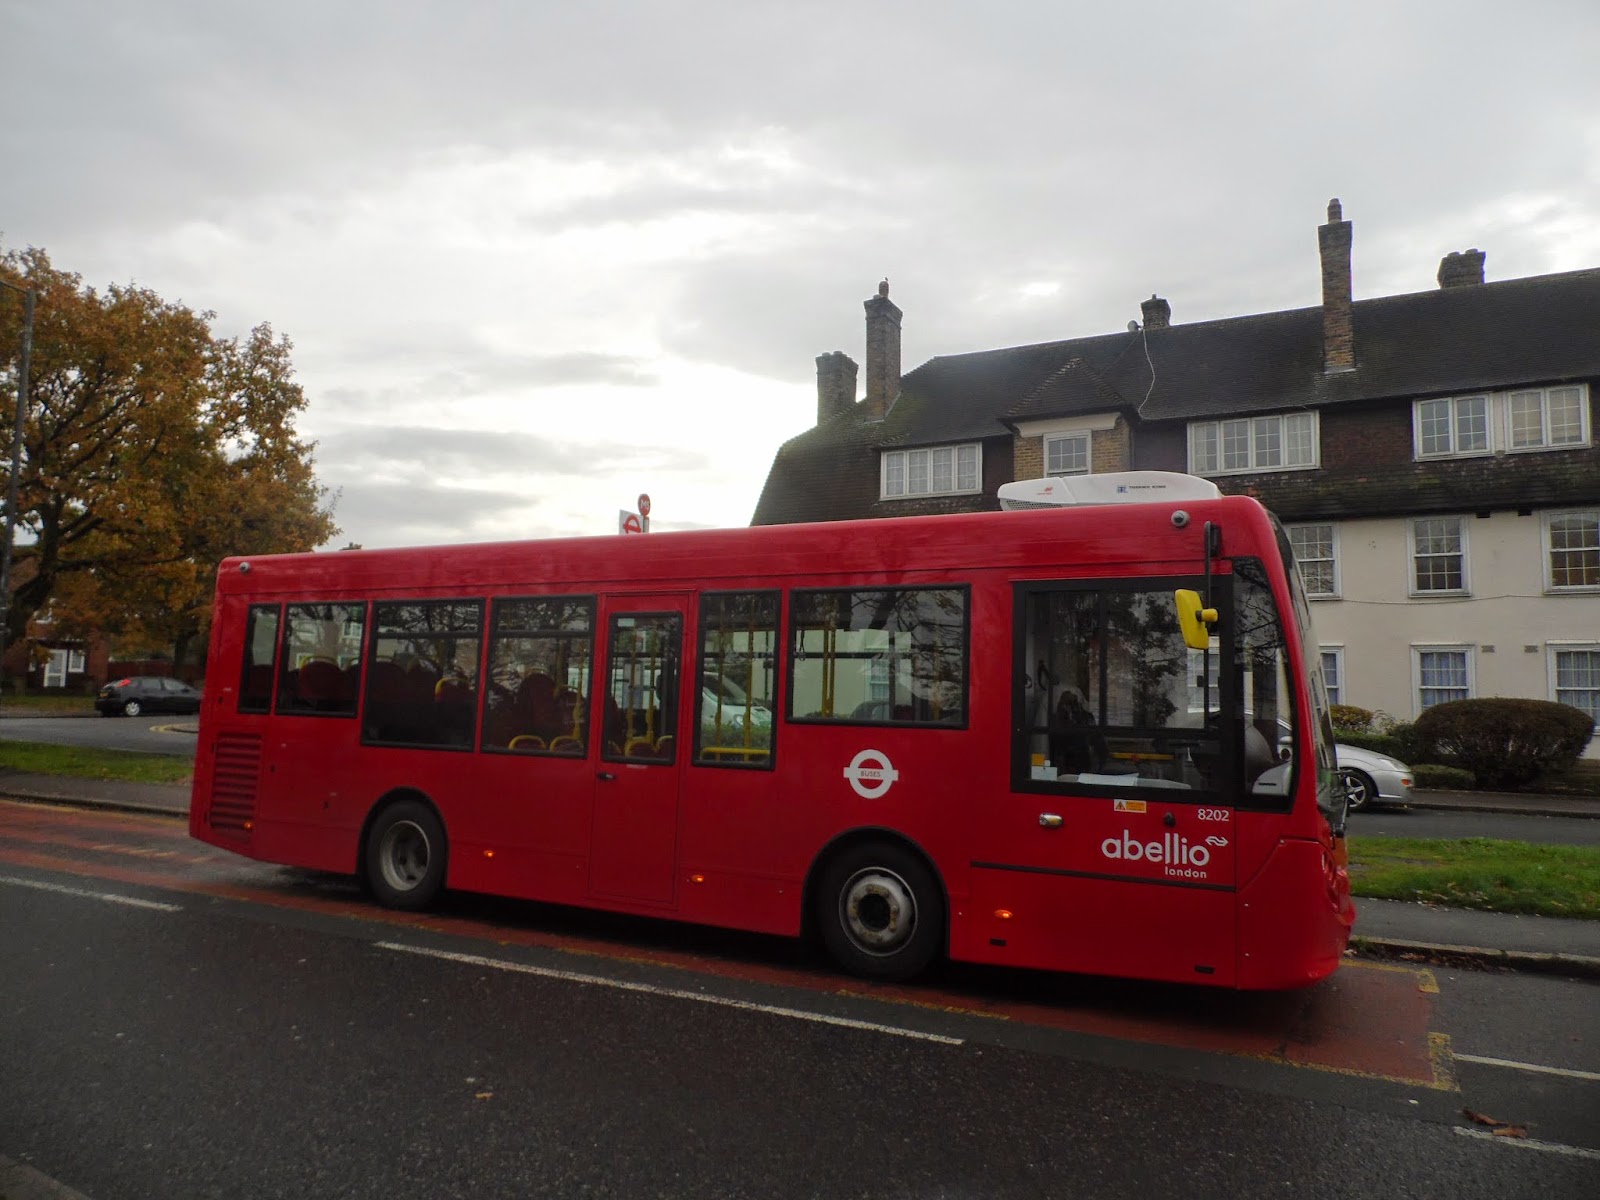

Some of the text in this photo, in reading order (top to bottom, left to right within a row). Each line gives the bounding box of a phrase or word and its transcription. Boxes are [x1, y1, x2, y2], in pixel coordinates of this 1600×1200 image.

[1197, 808, 1230, 822] 8202
[1101, 829, 1210, 866] abellio
[1164, 866, 1207, 878] london
